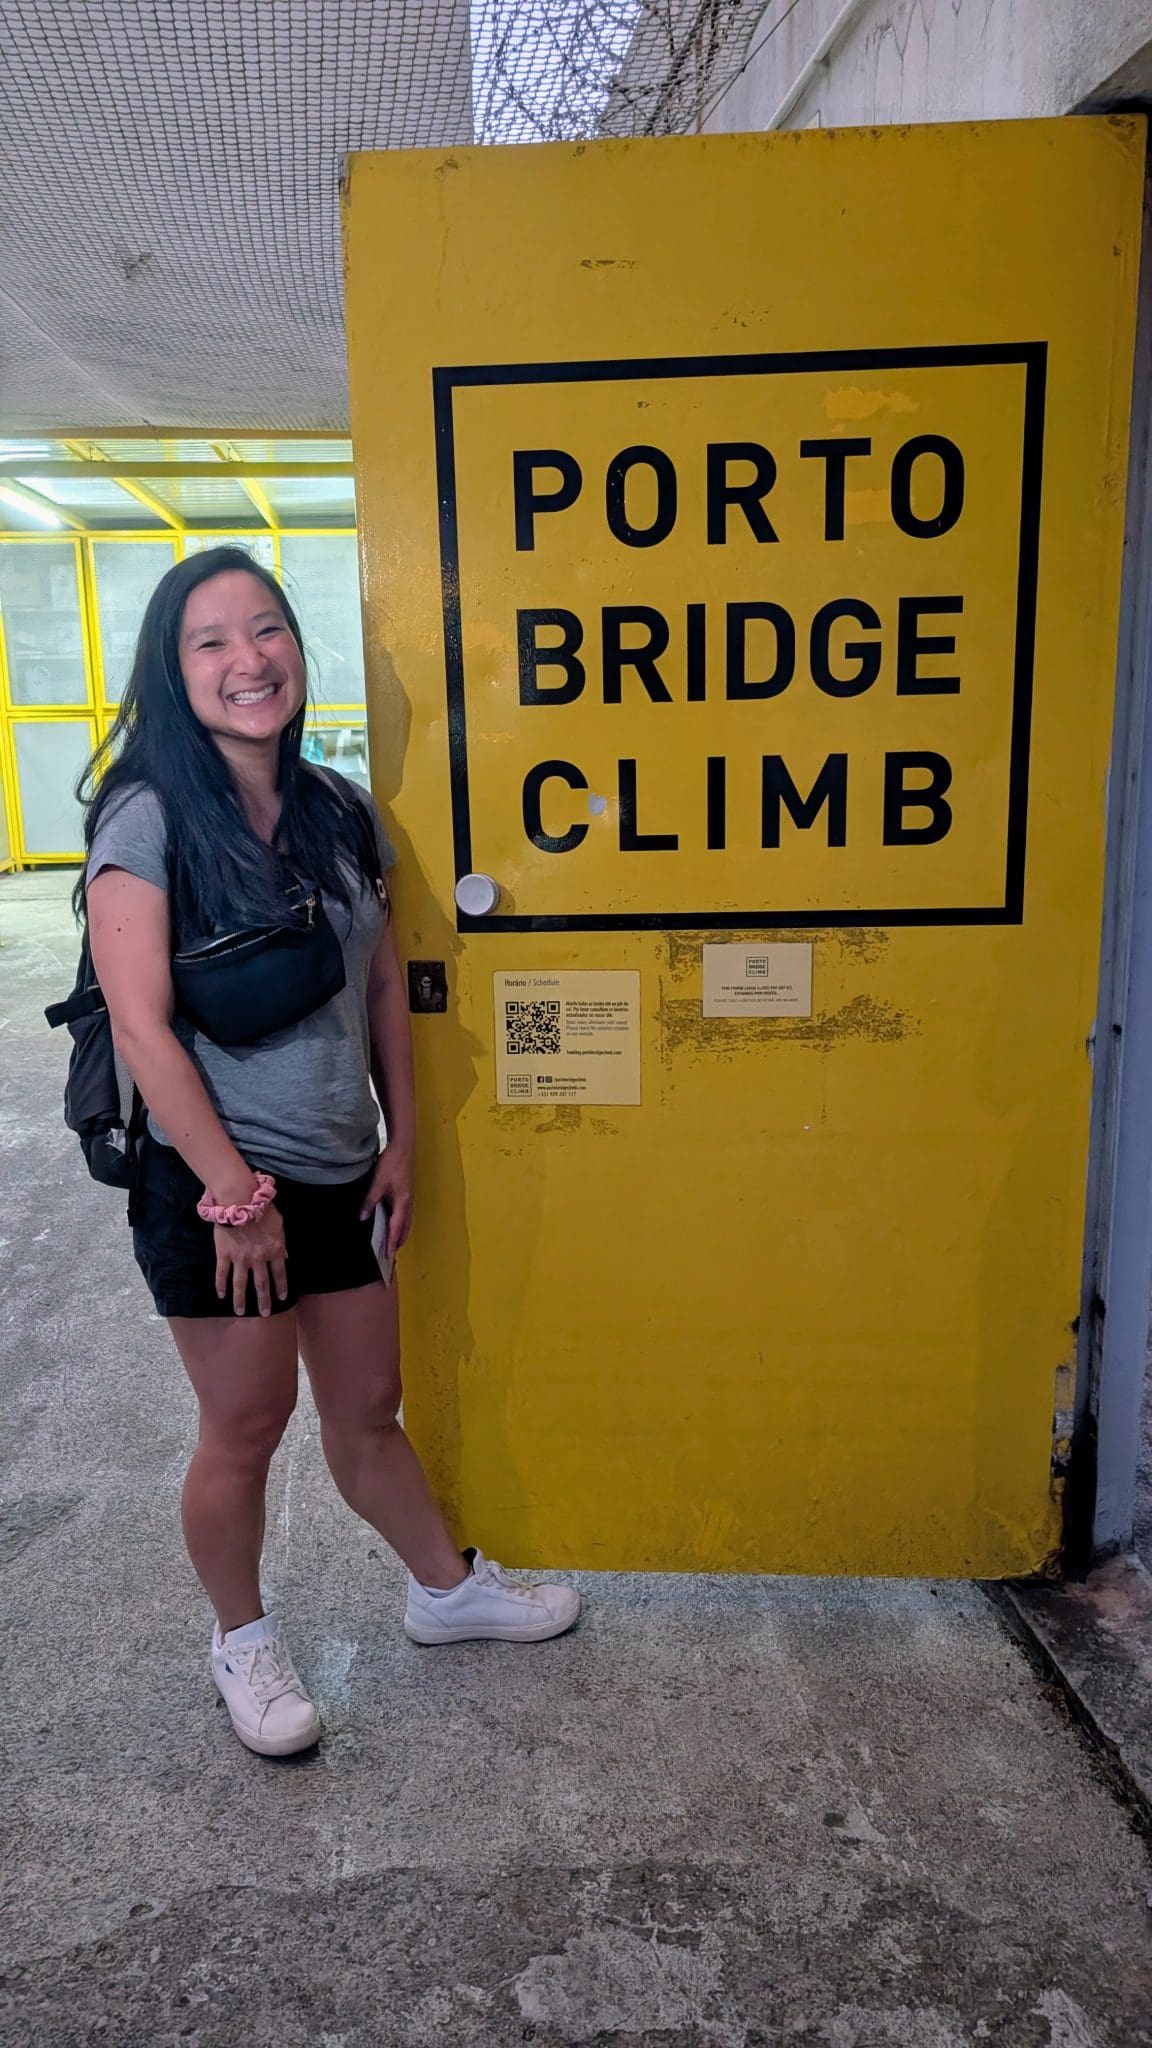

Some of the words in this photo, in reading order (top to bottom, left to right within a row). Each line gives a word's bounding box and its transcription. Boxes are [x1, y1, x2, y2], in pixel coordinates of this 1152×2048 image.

[513, 434, 965, 551] PORTO
[516, 596, 963, 706] BRIDGE
[522, 751, 953, 854] CLIMB
[504, 978, 527, 987] Horário
[532, 978, 560, 986] Schedule
